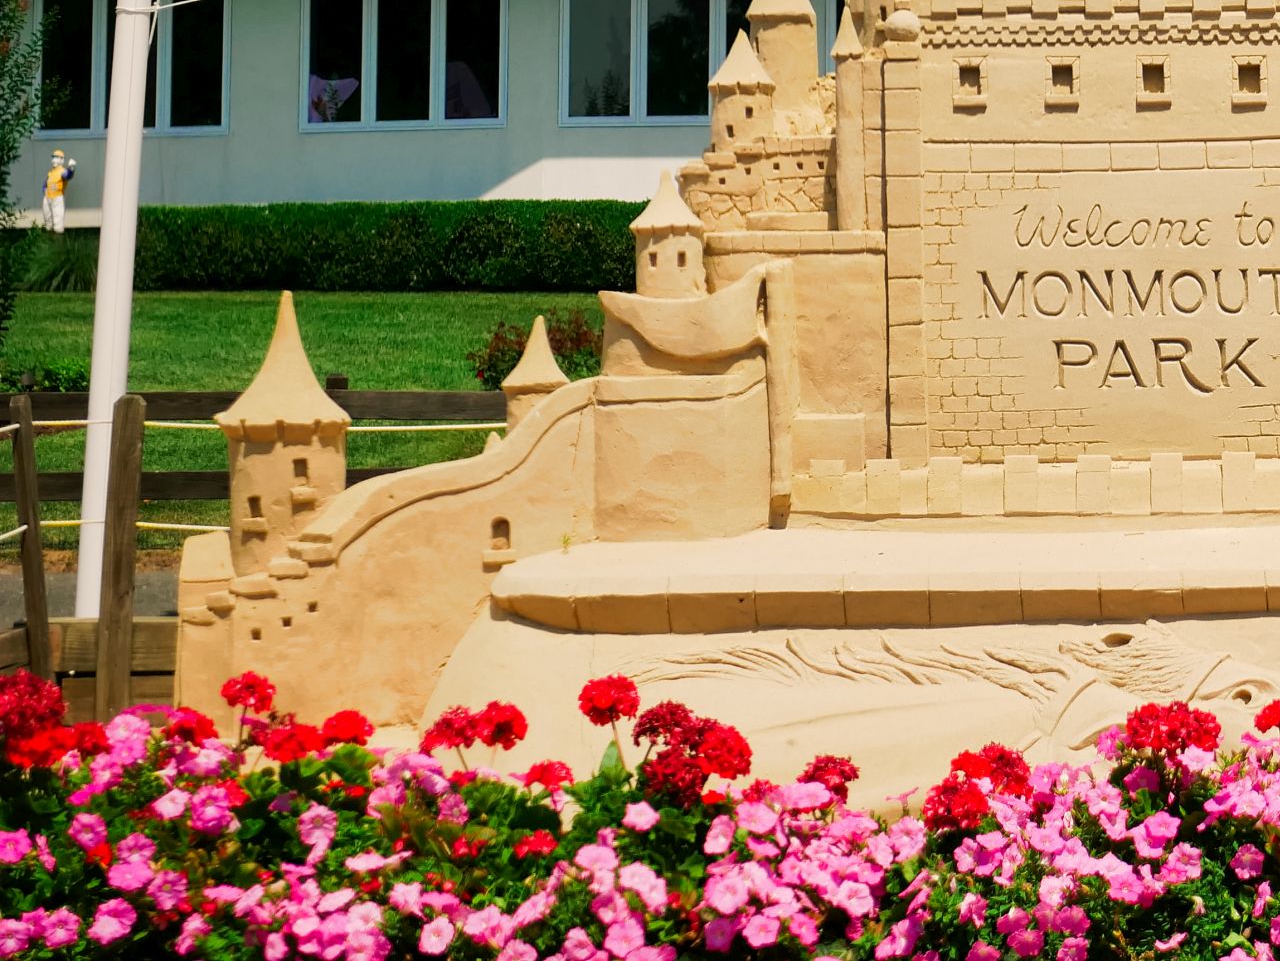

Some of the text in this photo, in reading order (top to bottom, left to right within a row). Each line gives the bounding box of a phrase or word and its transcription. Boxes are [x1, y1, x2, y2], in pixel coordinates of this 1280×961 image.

[1013, 200, 1276, 249] Welcome to
[1053, 337, 1267, 394] PARK
